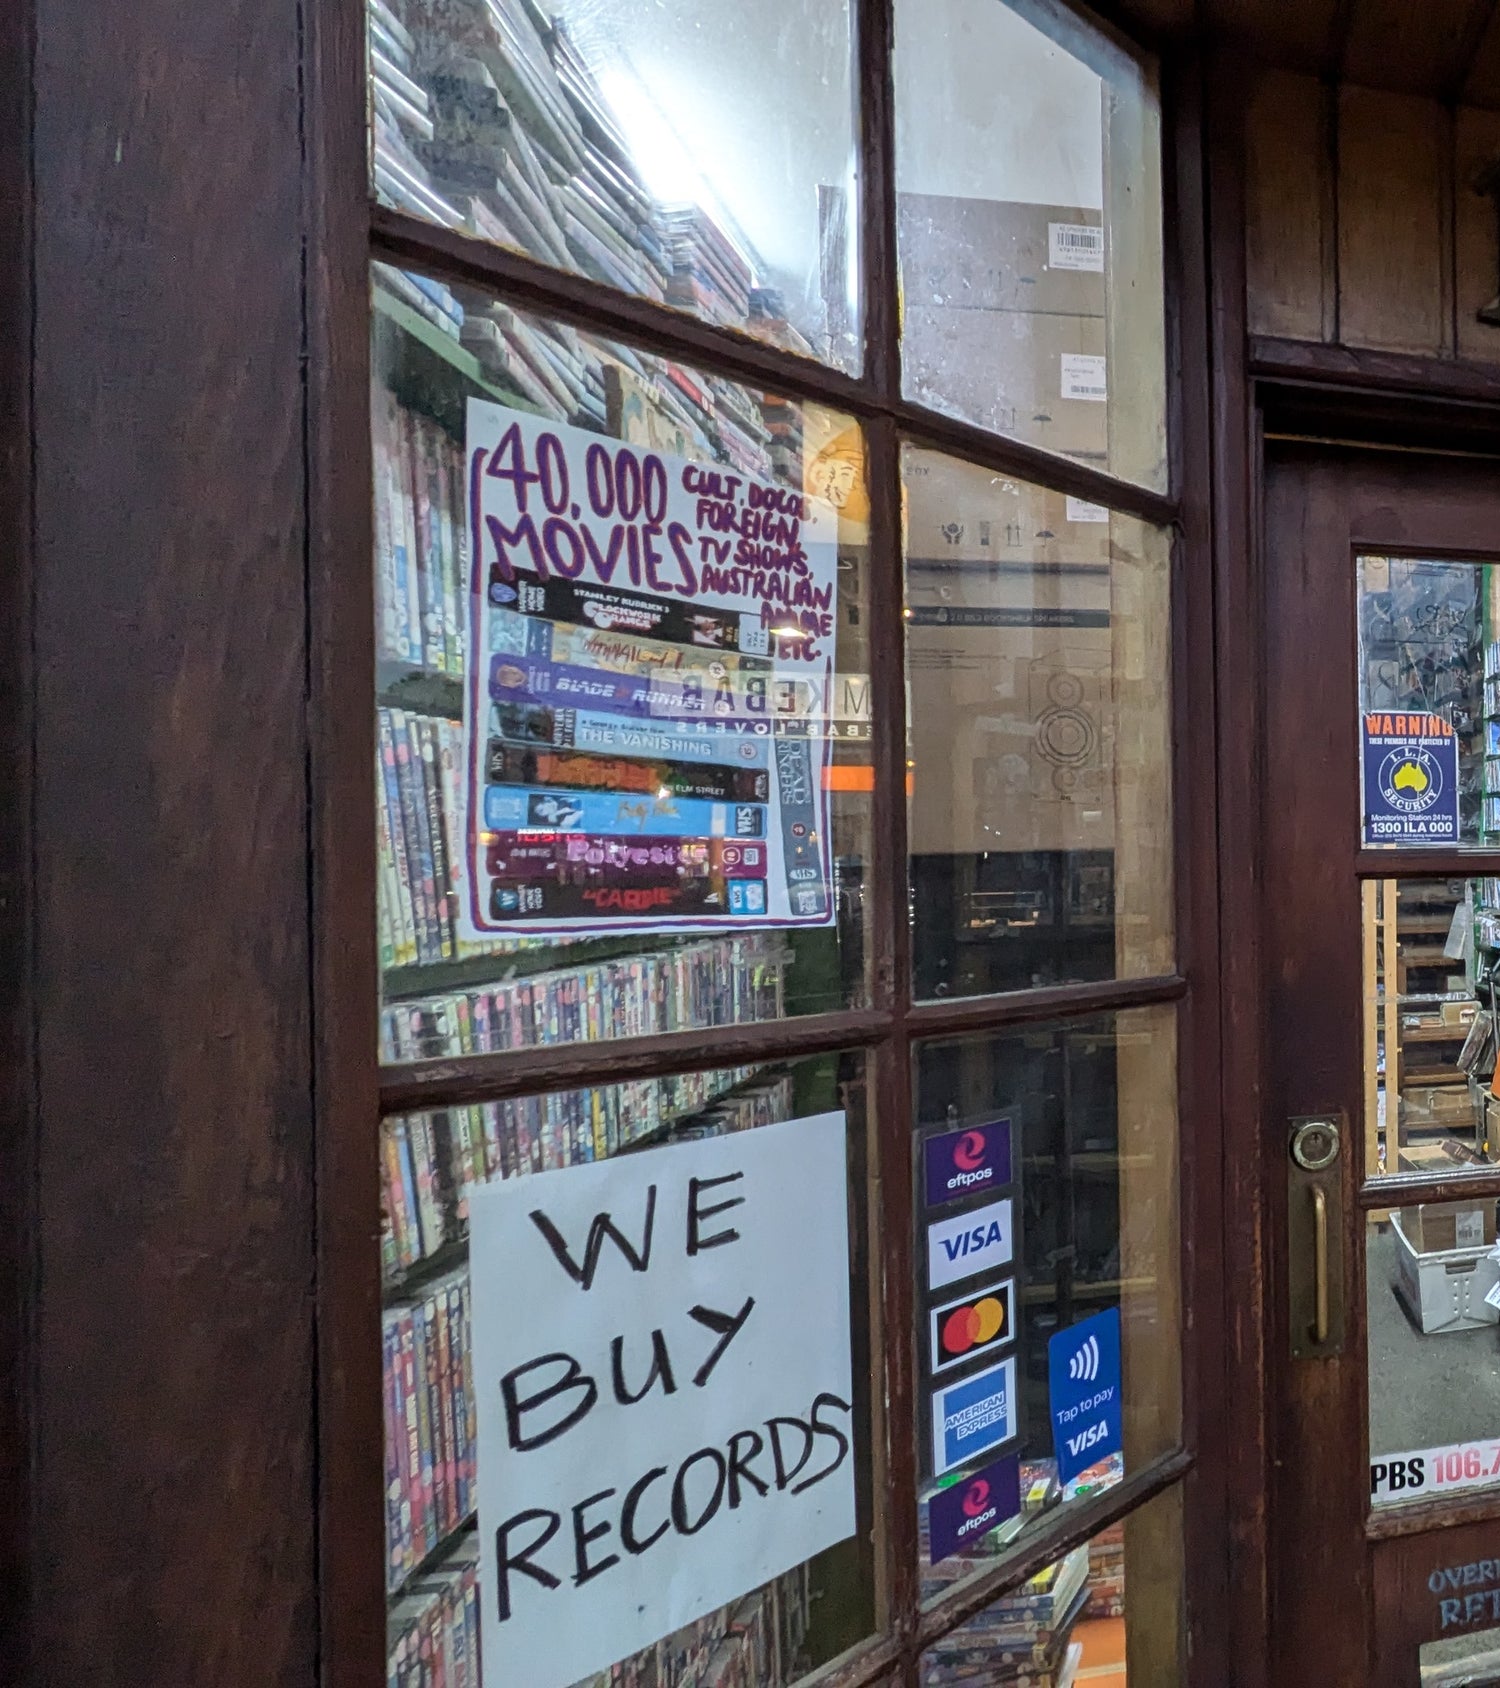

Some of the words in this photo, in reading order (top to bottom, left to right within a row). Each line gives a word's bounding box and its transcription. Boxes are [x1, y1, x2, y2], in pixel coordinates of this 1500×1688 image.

[486, 422, 668, 520] 40,000
[486, 513, 698, 598] MOVIES
[698, 537, 729, 564] TV
[573, 589, 619, 603] STANLEY
[702, 568, 832, 611] AUSTRALIAN
[556, 677, 615, 697] BLADE
[581, 726, 615, 745] THE
[620, 730, 713, 756] VANISHING
[1366, 715, 1453, 736] WARNING
[696, 785, 725, 796] STREET
[1384, 788, 1437, 811] SECURITY
[737, 807, 753, 834] VHS
[1371, 814, 1407, 822] Monitoring
[1371, 822, 1401, 833] 1300
[1404, 822, 1427, 833] ILA
[1429, 822, 1453, 833] 000
[947, 1167, 993, 1190] eftpos
[529, 1171, 745, 1291] WE
[938, 1221, 1002, 1262] VISA
[501, 1297, 755, 1453] BUY
[945, 1391, 1005, 1429] AMERICAN
[1056, 1408, 1078, 1425] Tap
[1080, 1396, 1092, 1413] to
[1092, 1386, 1114, 1409] pay
[957, 1406, 1008, 1440] EXPRESS
[1065, 1419, 1109, 1457] VISA
[1371, 1457, 1424, 1494] PBS
[496, 1392, 853, 1622] RECORDS
[957, 1506, 997, 1537] eftpos
